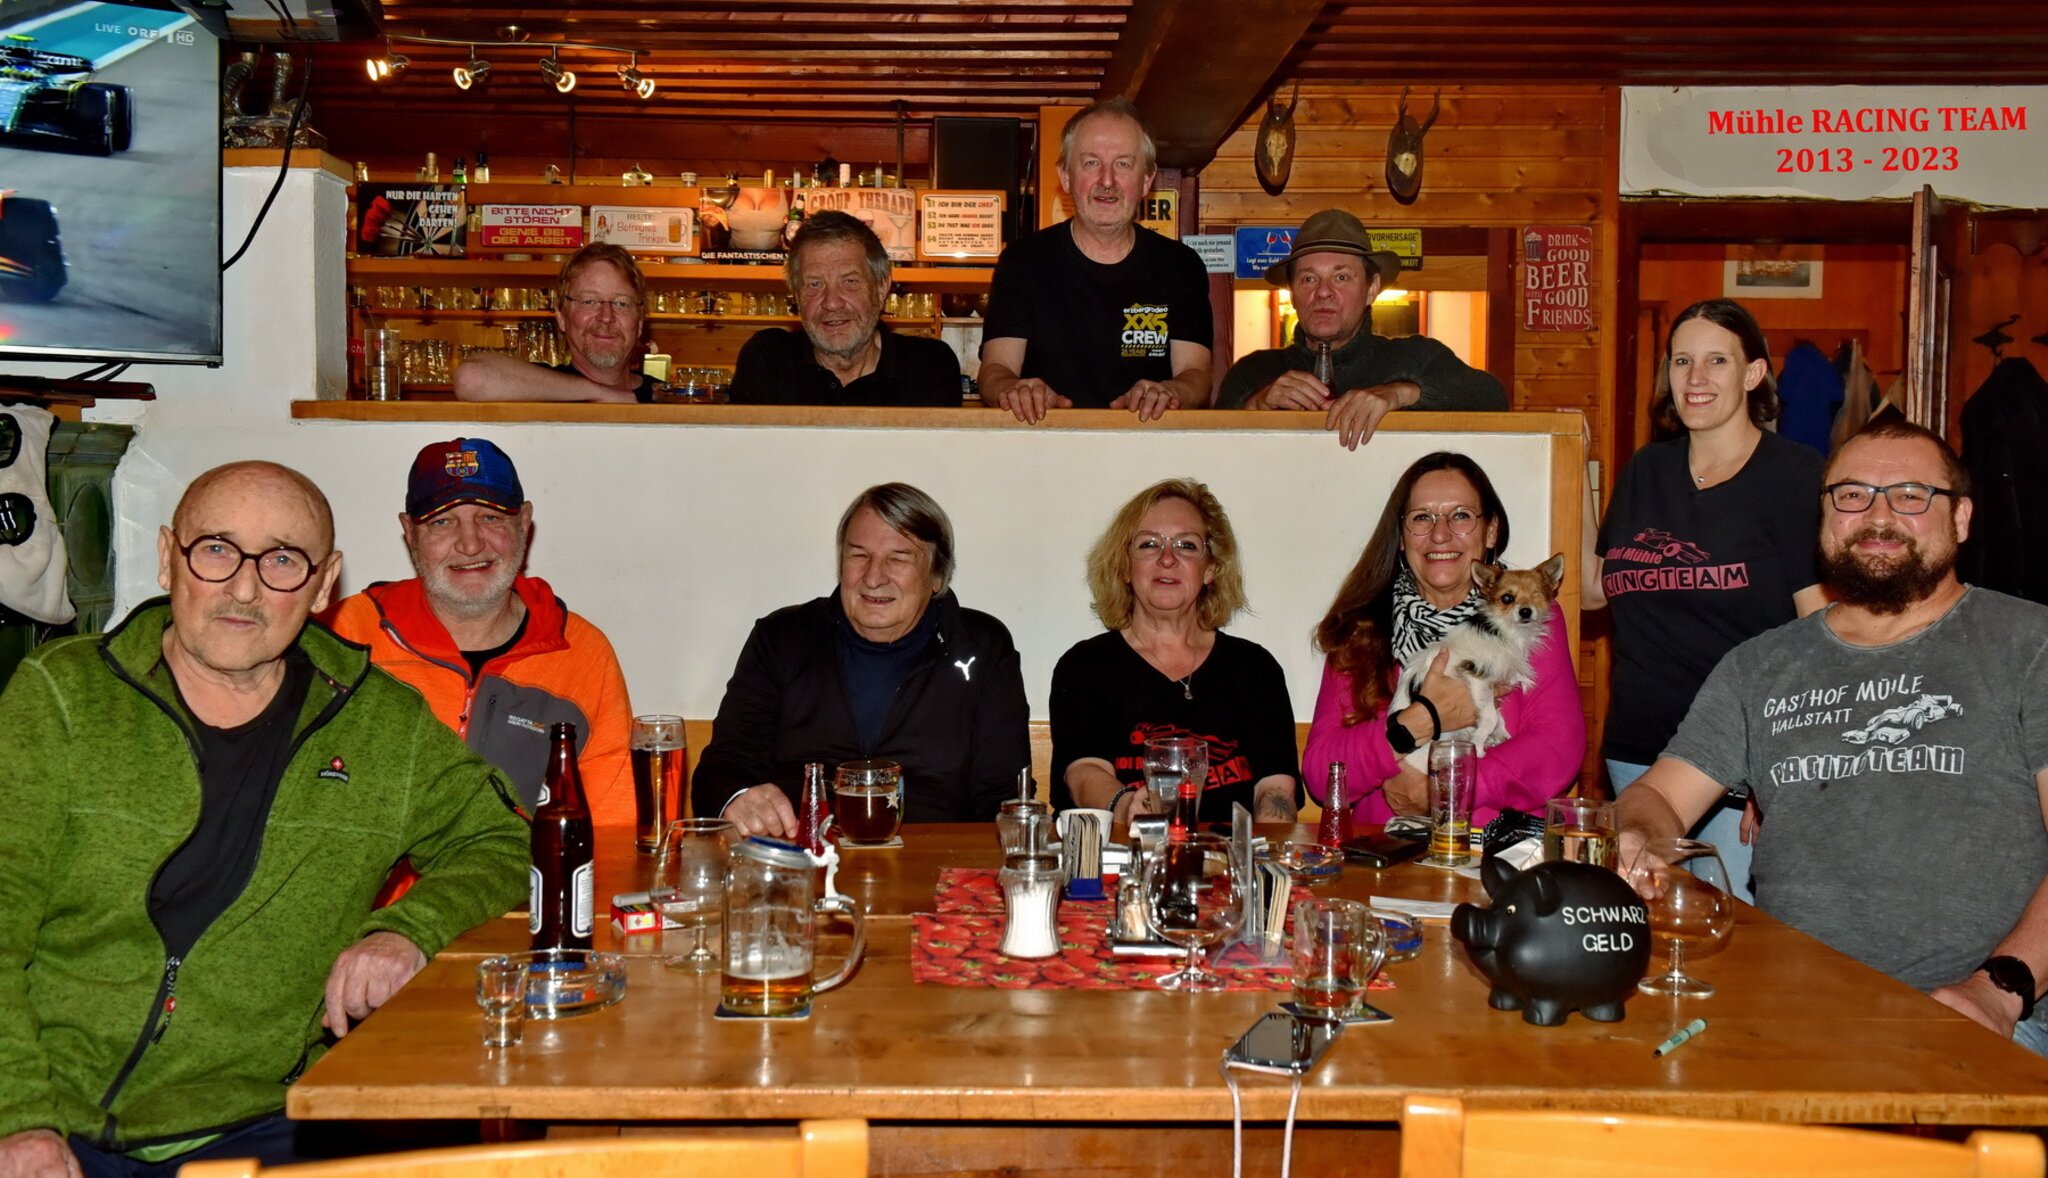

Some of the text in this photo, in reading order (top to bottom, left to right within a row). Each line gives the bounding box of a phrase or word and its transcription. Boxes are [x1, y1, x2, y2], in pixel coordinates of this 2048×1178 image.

[95, 23, 121, 34] LIVE
[176, 31, 195, 44] HD
[1707, 106, 2028, 135] Mühle RACING TEAM
[1776, 148, 1853, 173] 2013
[1881, 146, 1959, 172] 2023
[386, 190, 405, 200] NUR
[406, 190, 421, 200] DIE
[811, 192, 914, 216] GROUP THERAPY
[429, 204, 458, 214] GEHEN
[491, 207, 572, 216] BITTE NICHT
[504, 214, 560, 224] STÖREN
[491, 237, 573, 245] DER ARBEIT
[500, 228, 565, 236] GENIE BEI
[1547, 234, 1578, 247] DRINK
[702, 251, 716, 259] DIE
[717, 252, 783, 260] FANTASTISCHEN
[1547, 249, 1590, 262] GOOD
[1526, 262, 1589, 290] BEER
[1544, 287, 1588, 308] GOOD
[1527, 299, 1590, 326] FRIENDS
[1123, 313, 1168, 335] XX5
[1122, 331, 1168, 344] CREW
[1603, 563, 1749, 597] CINGTEAM
[1764, 685, 1849, 717] GASTHOF
[1772, 709, 1852, 736] HALLSTATT
[1562, 906, 1646, 925] SCHWARZ
[1583, 932, 1633, 952] GELD
